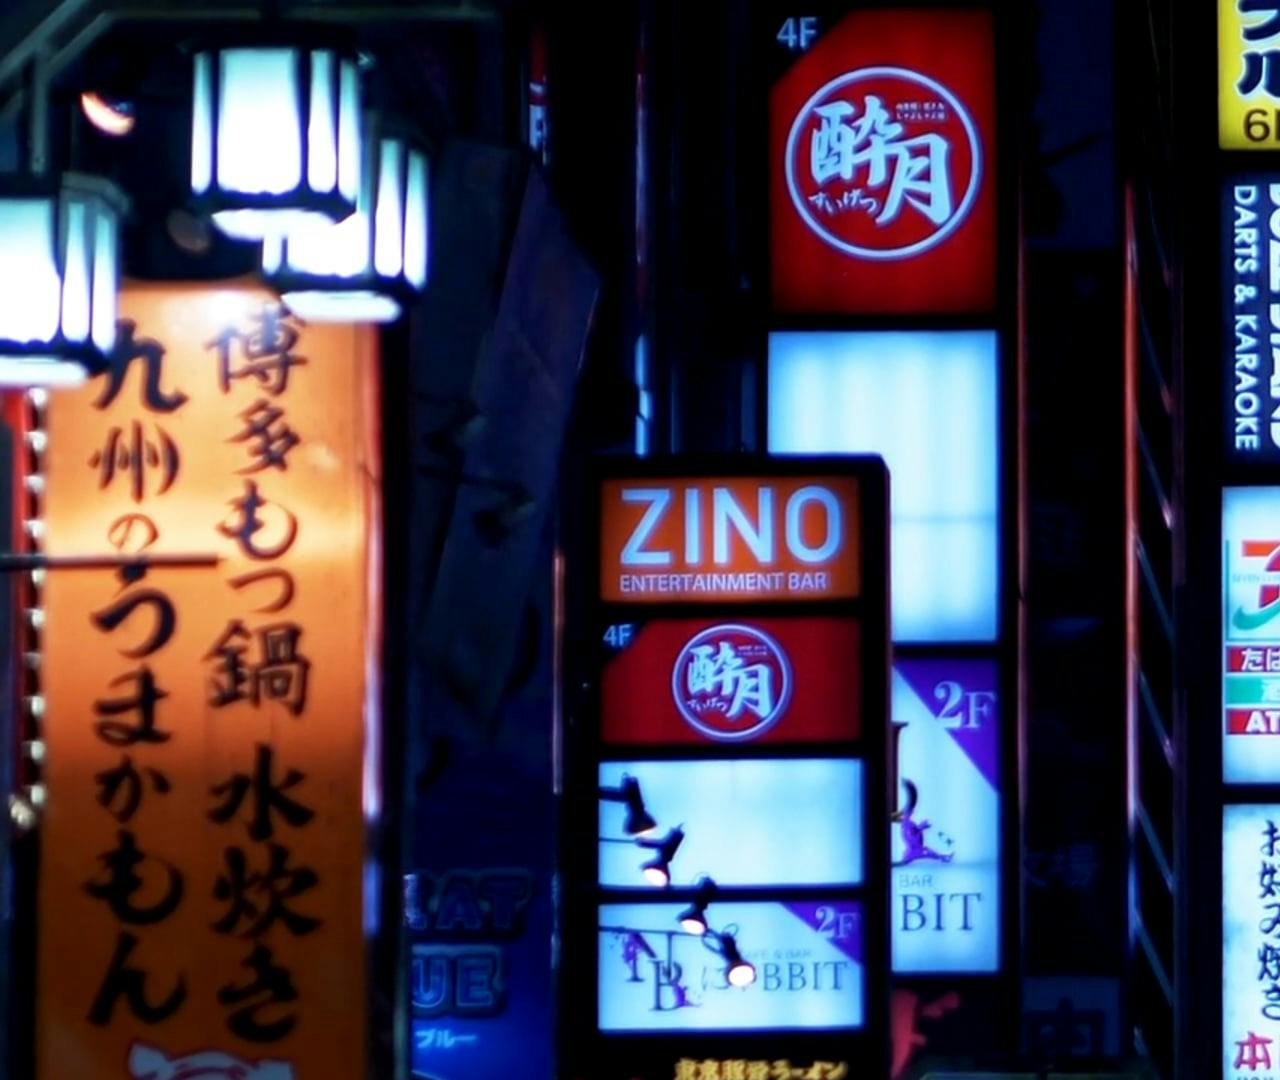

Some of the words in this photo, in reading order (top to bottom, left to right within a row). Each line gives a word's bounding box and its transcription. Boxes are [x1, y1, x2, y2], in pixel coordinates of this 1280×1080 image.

[777, 17, 816, 48] 4F
[809, 95, 953, 224] 酔月
[1234, 185, 1259, 273] DARTS
[1234, 284, 1258, 303] &
[1234, 315, 1260, 451] KARAOKE
[202, 302, 310, 715] 博多もつ鍋
[619, 487, 845, 565] ZINO
[619, 573, 783, 593] ENTERTAINMENT
[788, 572, 827, 590] BAR
[84, 316, 188, 1026] 九州のうまかもん
[604, 624, 632, 647] 4F
[687, 641, 771, 718] 酔月
[934, 682, 997, 730] 2F
[206, 742, 323, 1044] 水炊き
[816, 906, 857, 939] 2F
